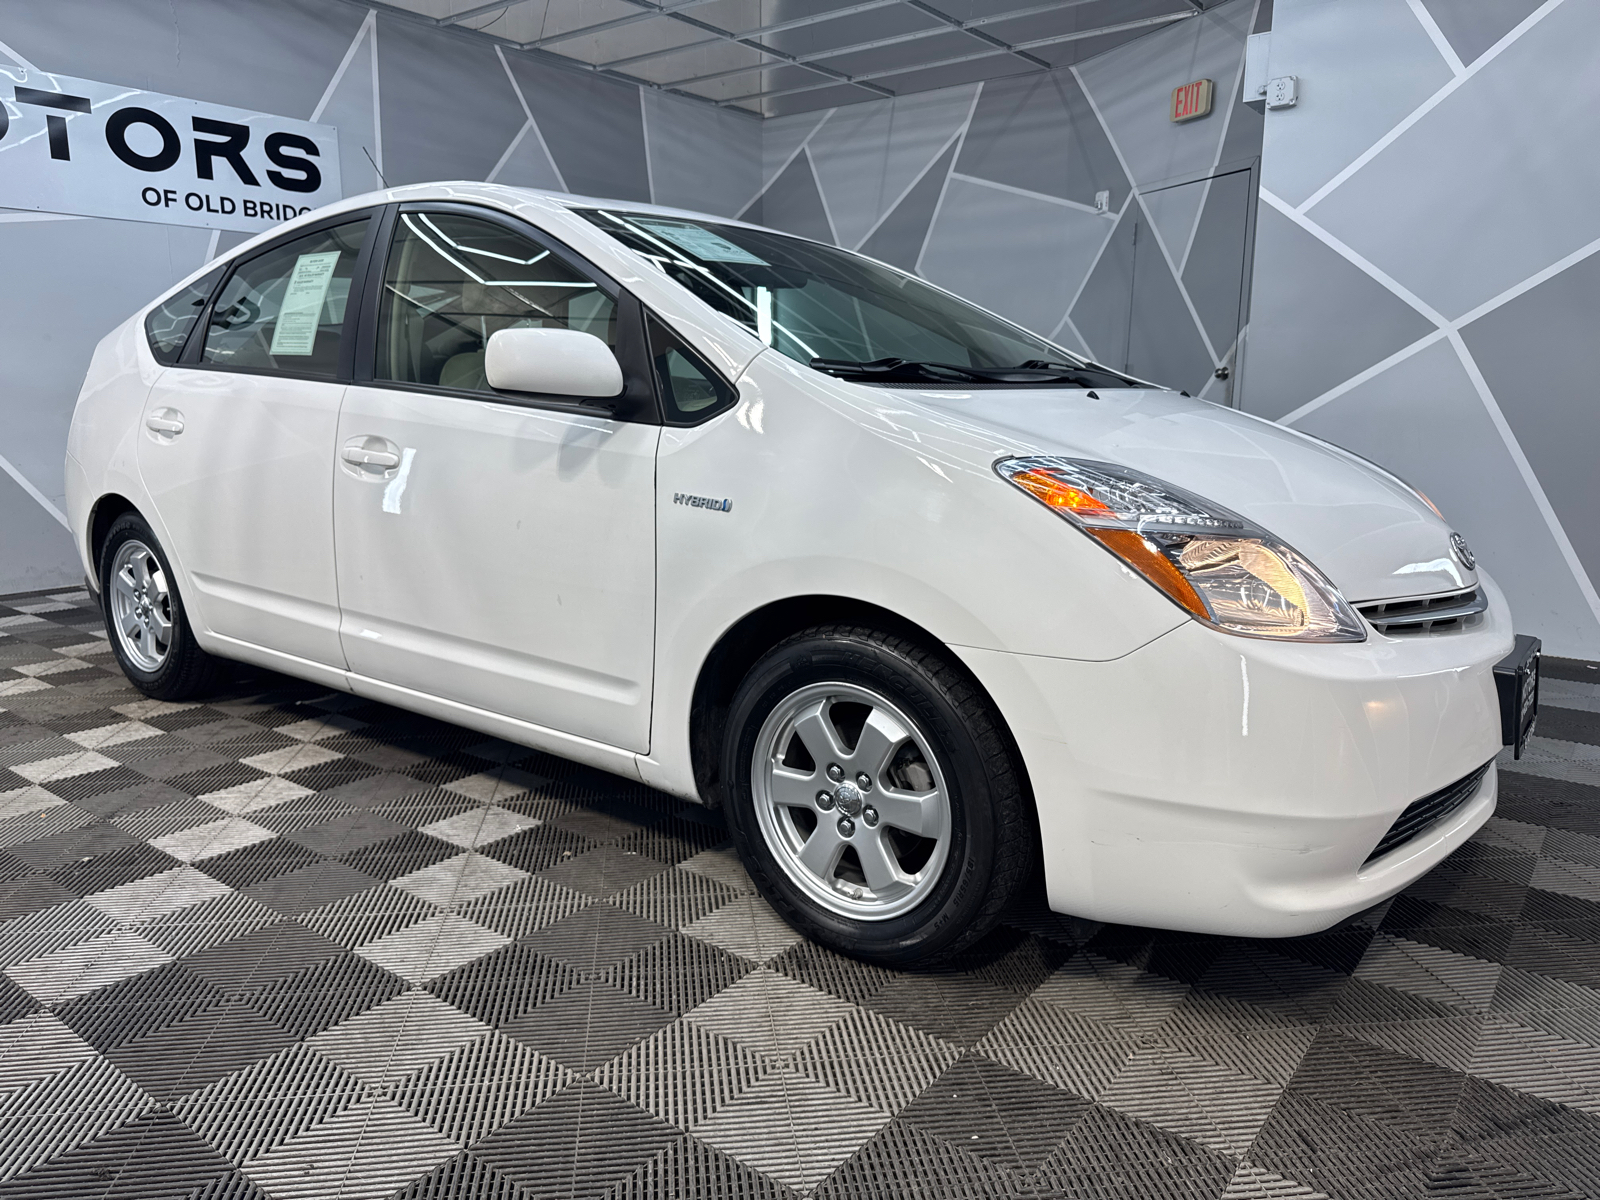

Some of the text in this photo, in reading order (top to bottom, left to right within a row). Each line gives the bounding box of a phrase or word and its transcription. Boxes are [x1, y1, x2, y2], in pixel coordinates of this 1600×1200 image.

[1174, 81, 1202, 118] EXIT
[0, 86, 322, 193] TORS
[141, 186, 316, 222] OF OLD BRID
[673, 492, 723, 512] HYBRID
[933, 912, 950, 931] M+S
